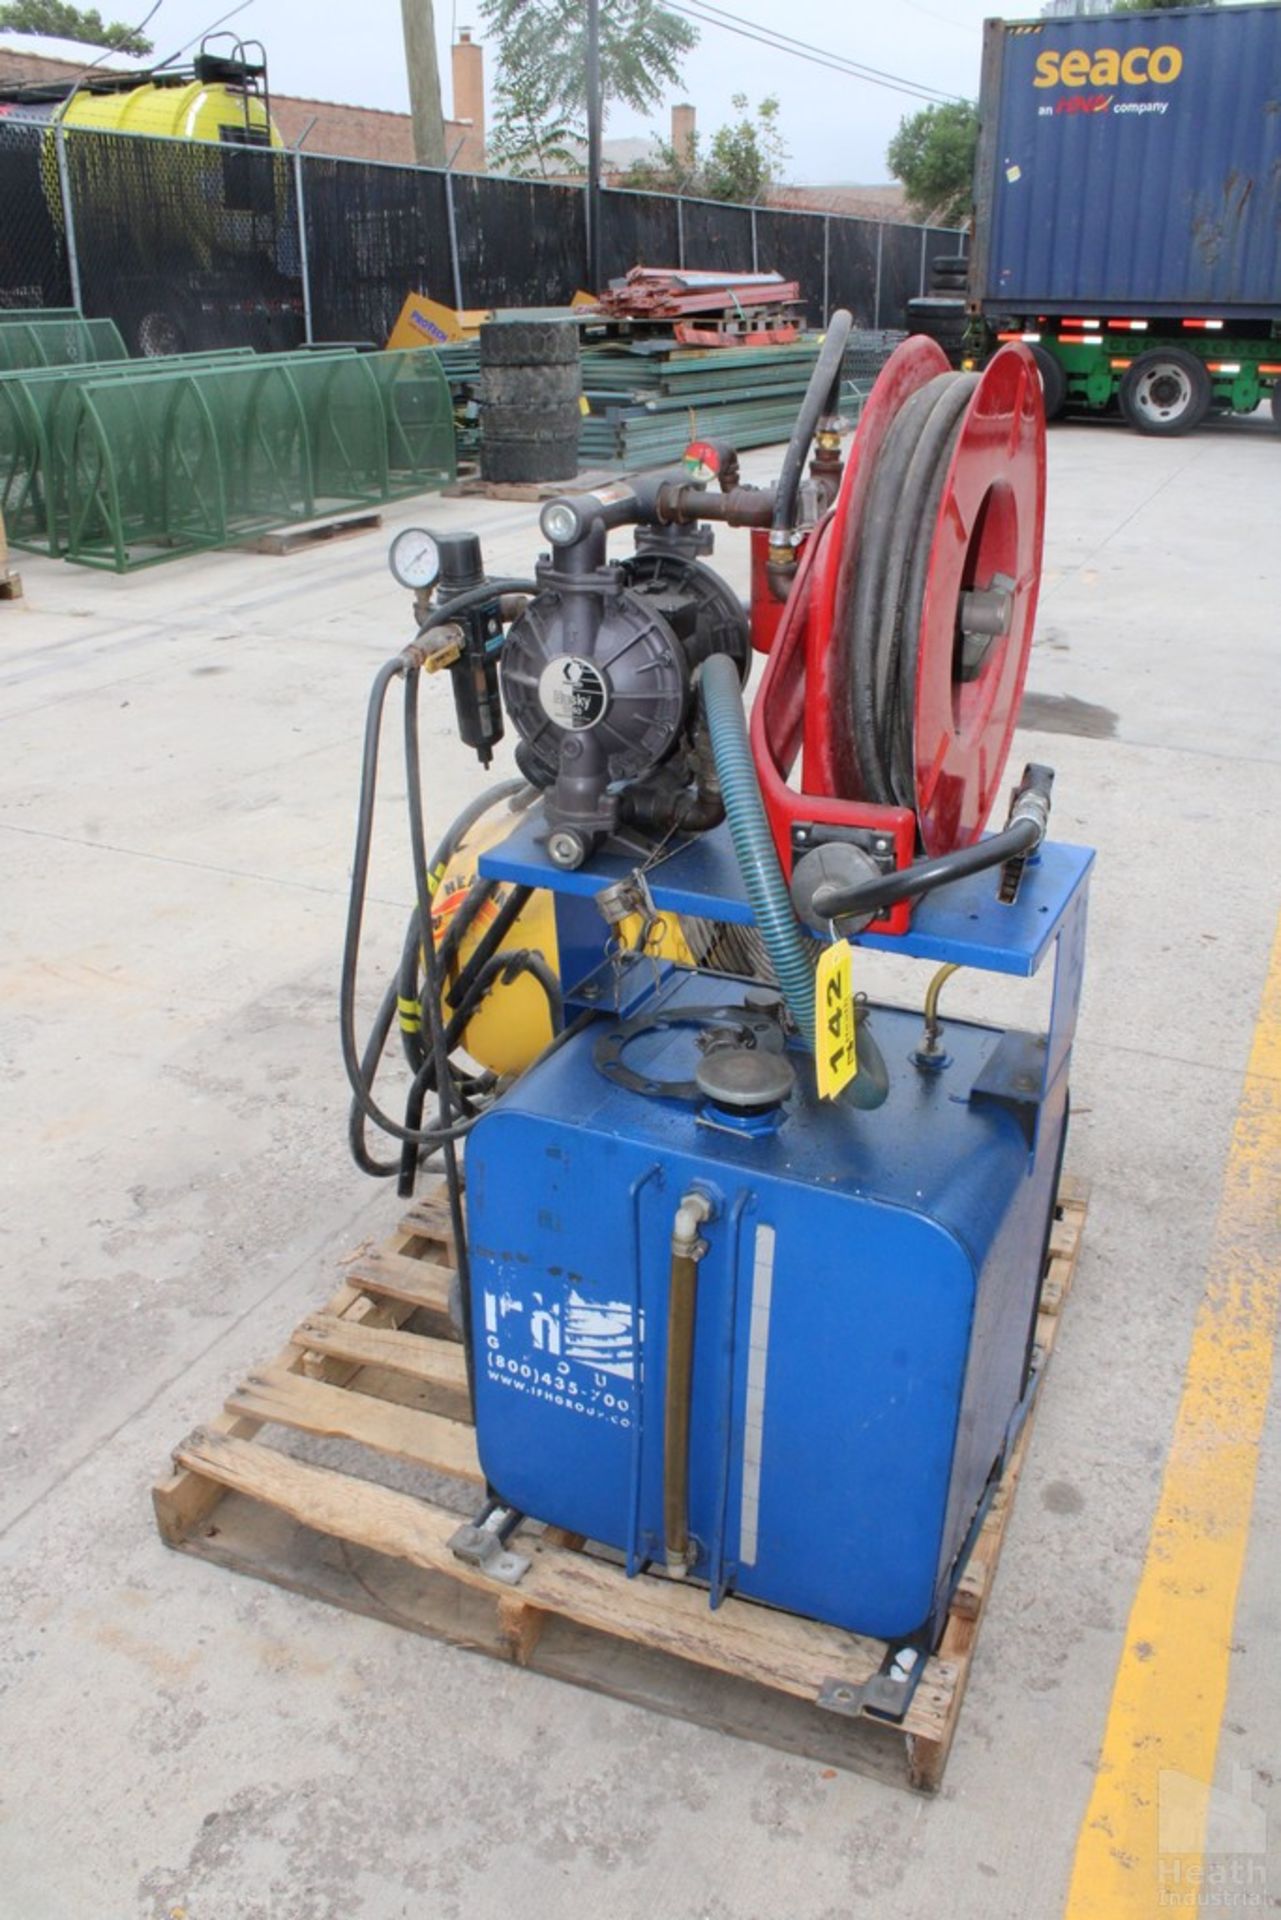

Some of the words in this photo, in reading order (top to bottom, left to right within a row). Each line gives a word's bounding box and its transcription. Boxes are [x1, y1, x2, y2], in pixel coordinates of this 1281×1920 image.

[1032, 45, 1183, 88] seaco
[1037, 105, 1054, 116] an
[1113, 101, 1169, 115] company
[826, 970, 845, 1074] 142
